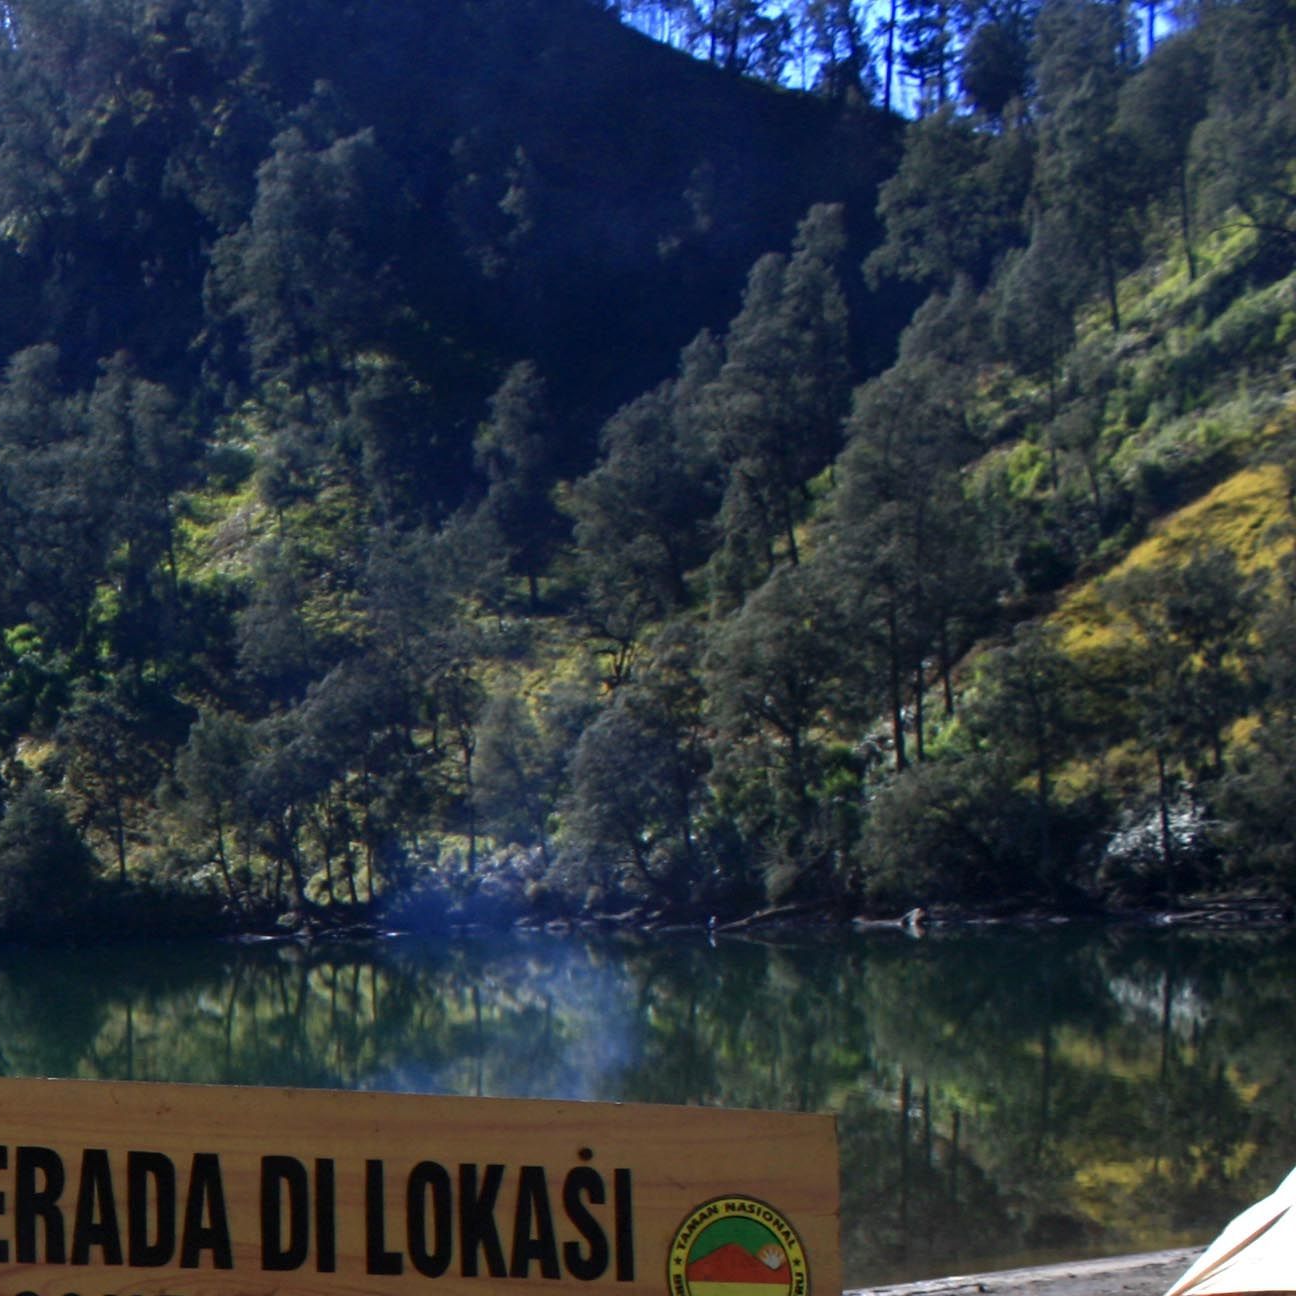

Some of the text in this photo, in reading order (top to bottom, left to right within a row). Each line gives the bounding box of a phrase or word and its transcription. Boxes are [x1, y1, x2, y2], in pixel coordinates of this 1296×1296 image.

[259, 1155, 336, 1274] DI
[364, 1159, 635, 1283] LOKASI
[676, 1202, 796, 1251] TAMAN NASIONAL
